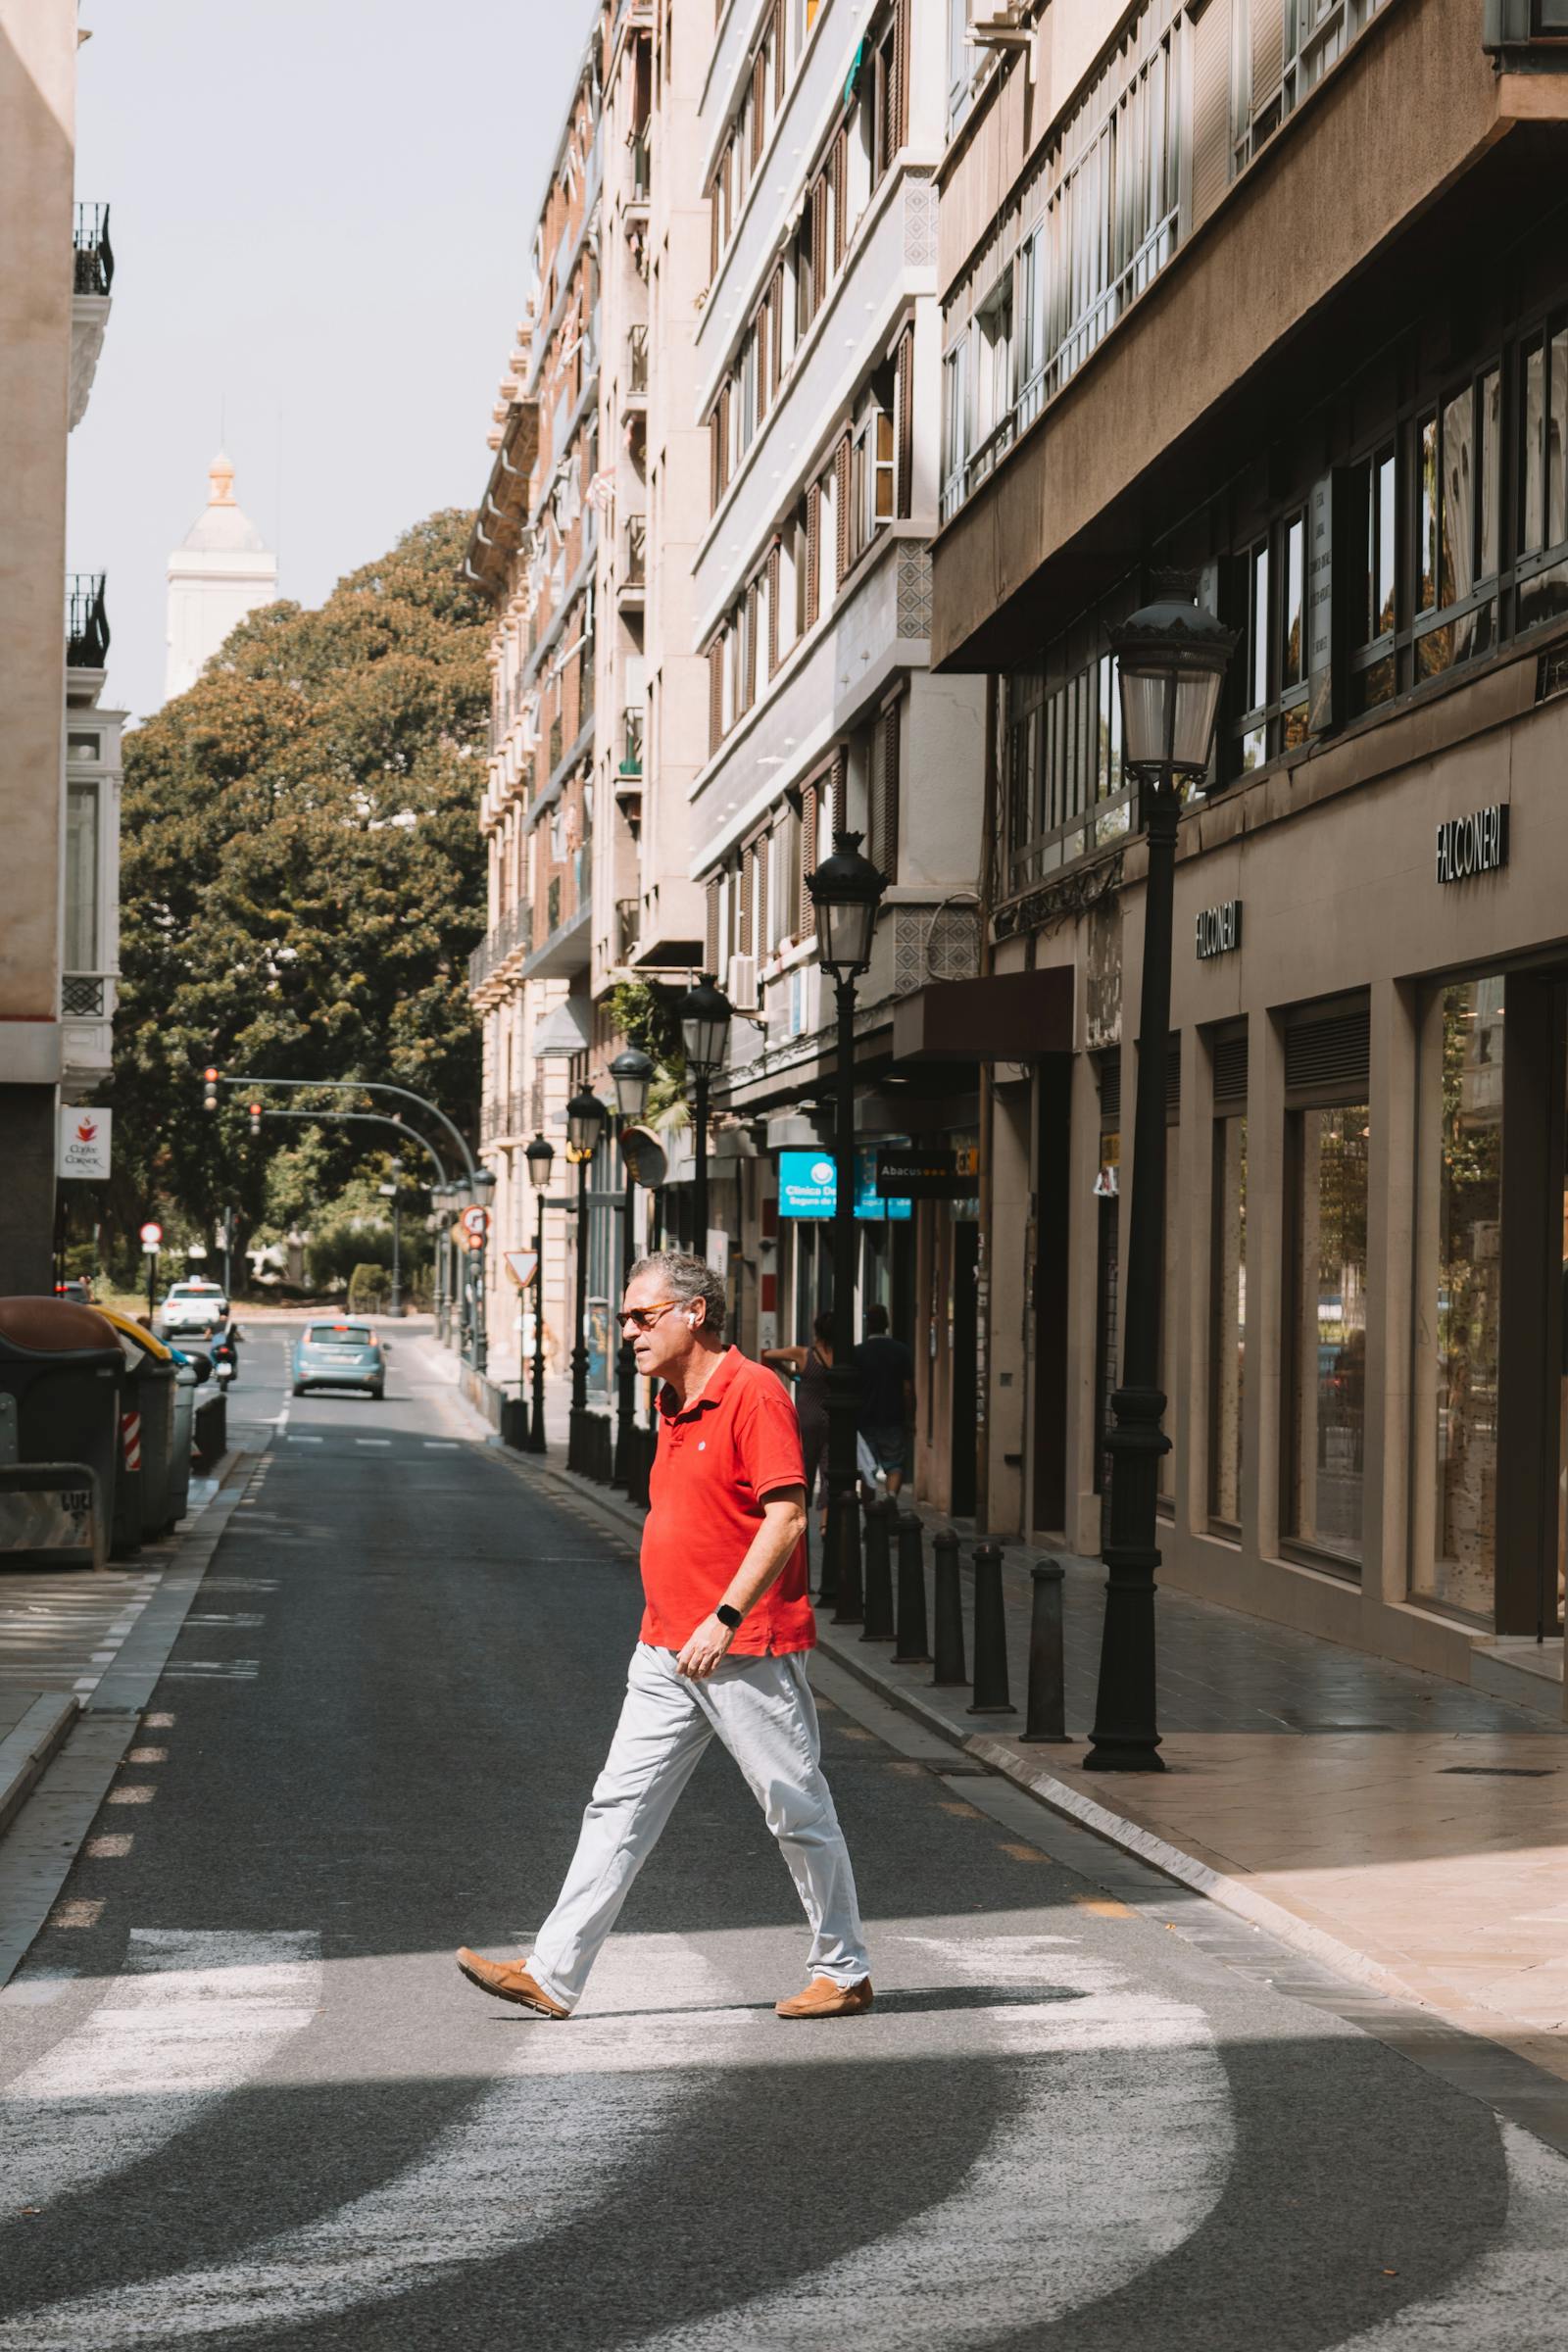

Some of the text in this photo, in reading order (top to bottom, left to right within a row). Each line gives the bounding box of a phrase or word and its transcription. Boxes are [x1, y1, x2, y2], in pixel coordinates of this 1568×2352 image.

[1436, 804, 1500, 883] FALCONERI
[1196, 901, 1236, 959] FALCONERI
[881, 1165, 921, 1176] Abacus
